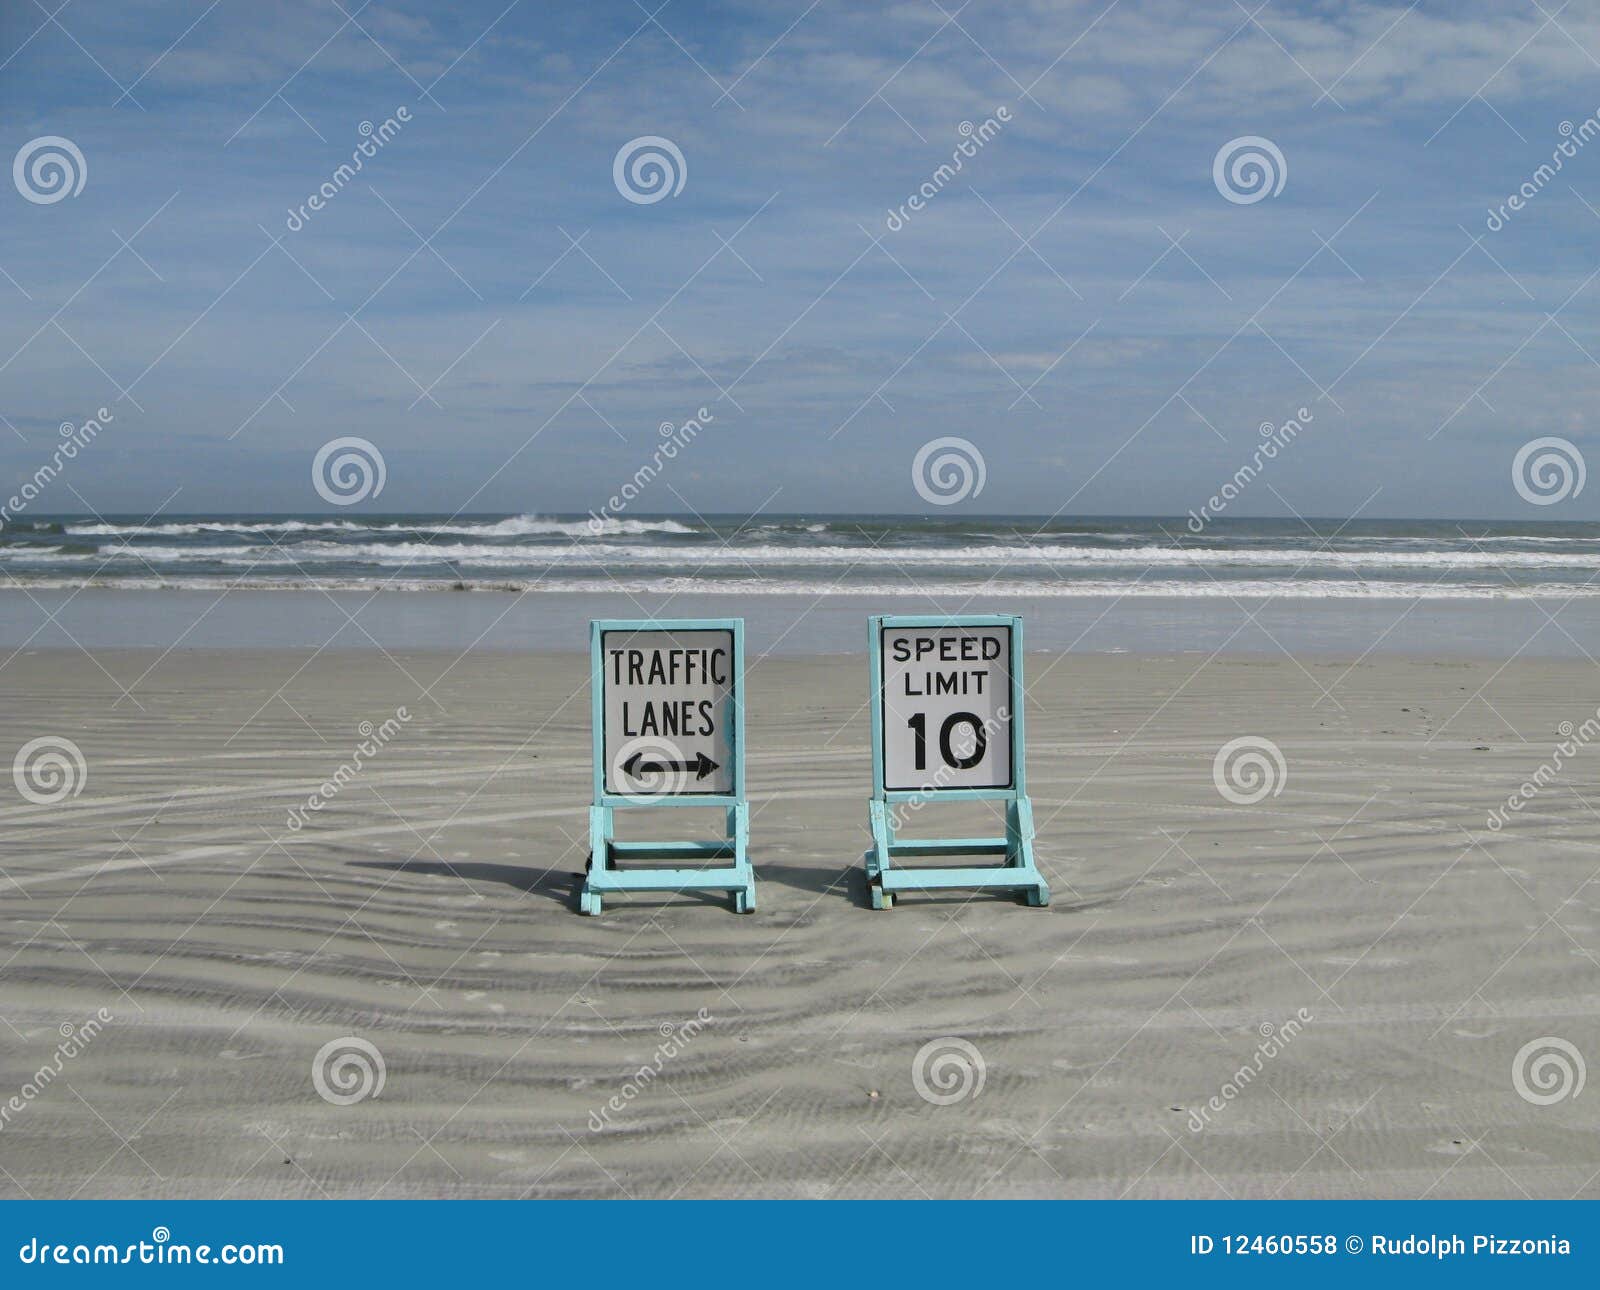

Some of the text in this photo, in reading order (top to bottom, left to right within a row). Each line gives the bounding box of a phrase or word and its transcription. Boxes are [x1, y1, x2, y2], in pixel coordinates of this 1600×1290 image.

[610, 648, 726, 685] TRAFFIC
[893, 636, 1001, 662] SPEED
[905, 671, 989, 696] LIMIT
[623, 700, 715, 737] LANES
[907, 711, 987, 771] 10
